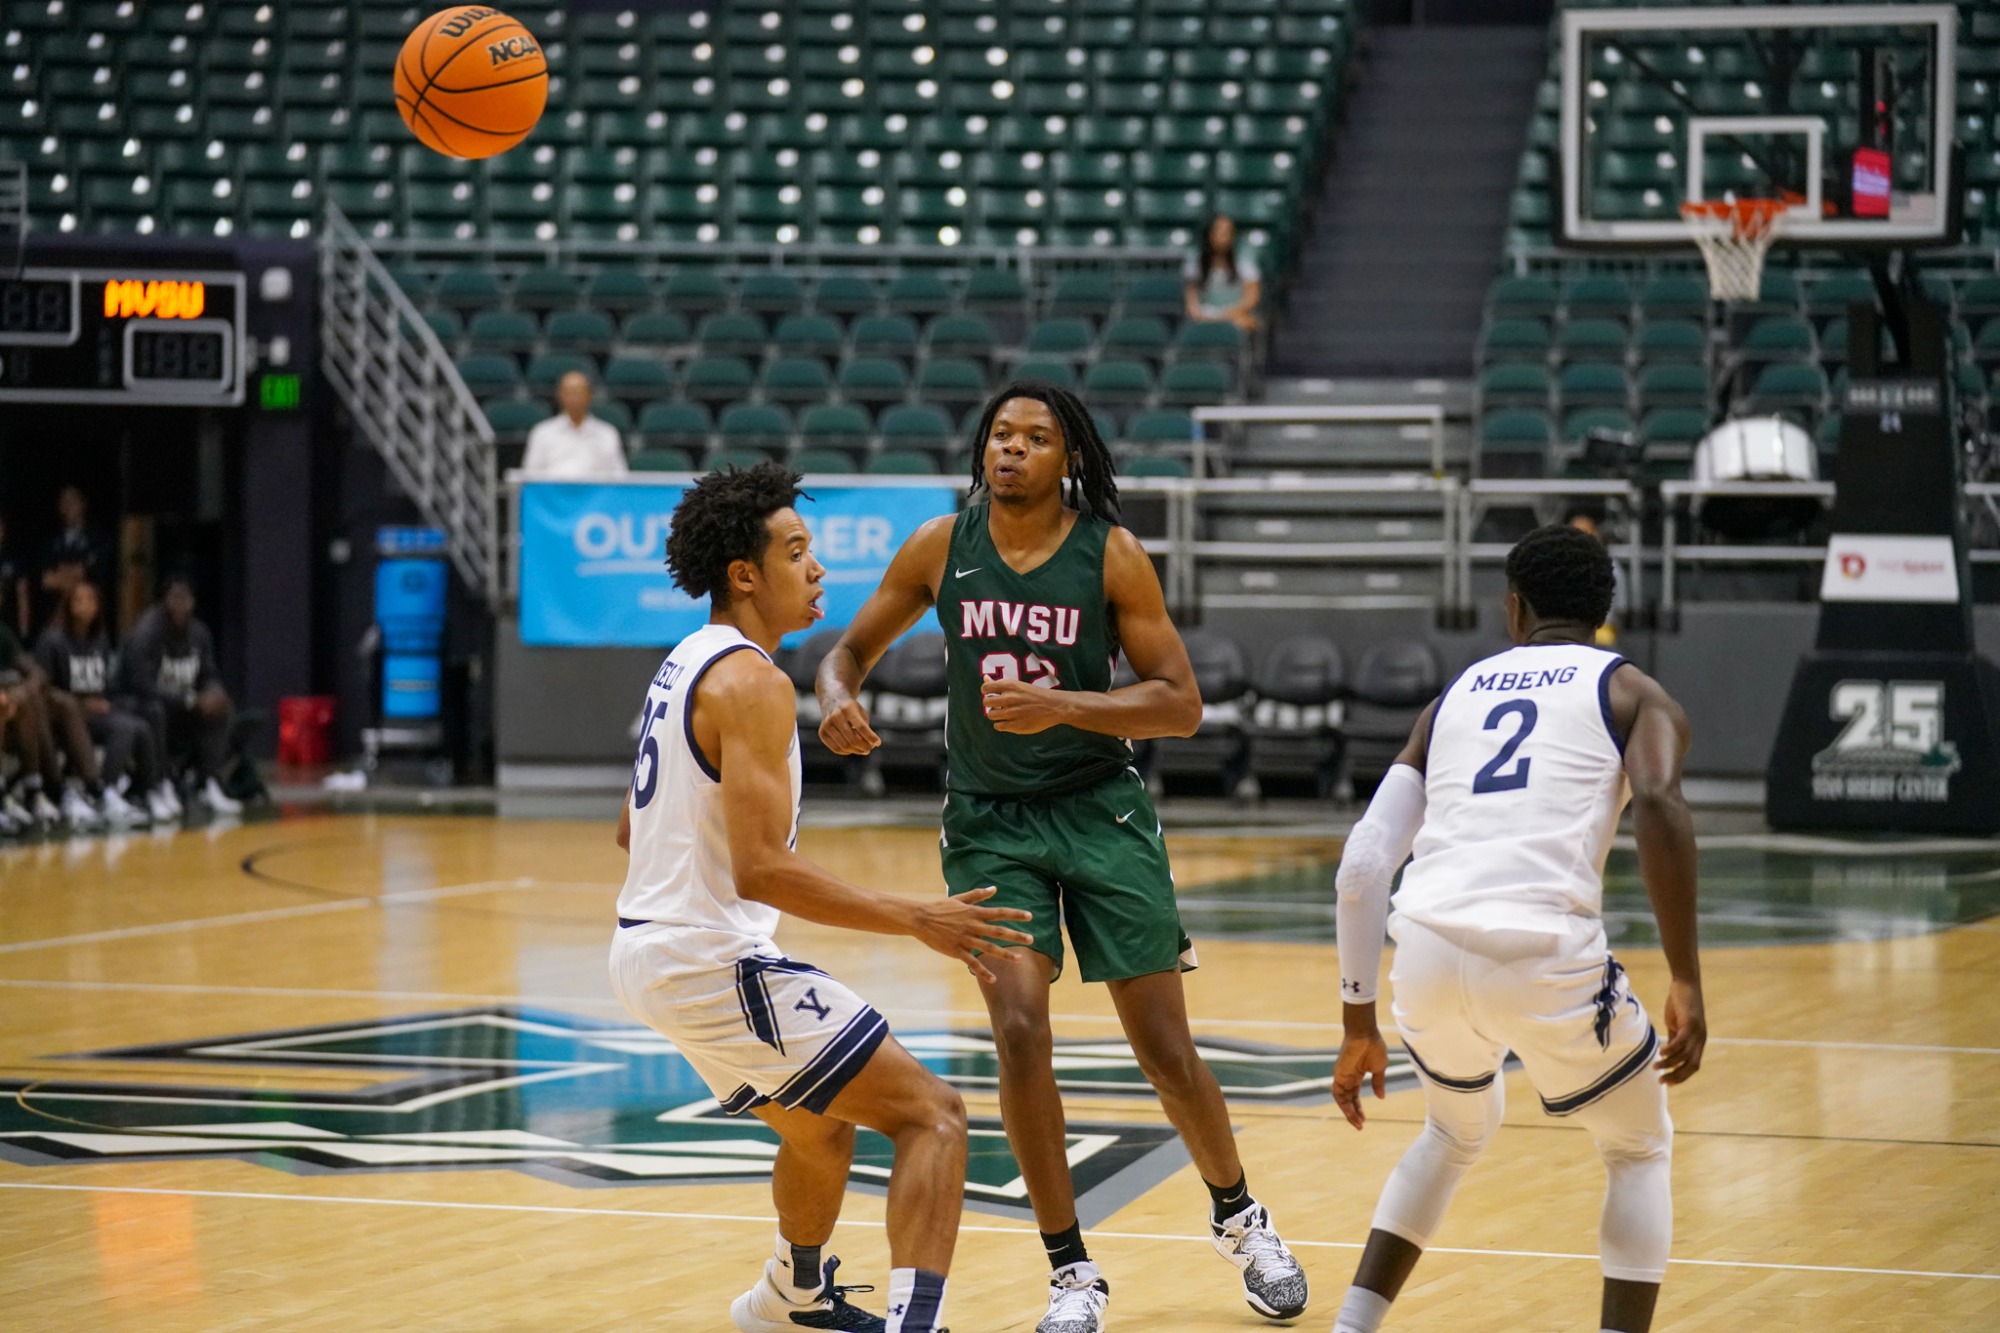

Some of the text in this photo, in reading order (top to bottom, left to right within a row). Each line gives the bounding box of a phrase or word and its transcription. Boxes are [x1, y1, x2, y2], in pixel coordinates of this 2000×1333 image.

[104, 279, 204, 318] MVSU
[960, 600, 1080, 646] MVSU
[1470, 667, 1577, 692] MBENG
[1829, 680, 1945, 753] 25
[1472, 699, 1538, 794] 2
[794, 987, 831, 1021] Y
